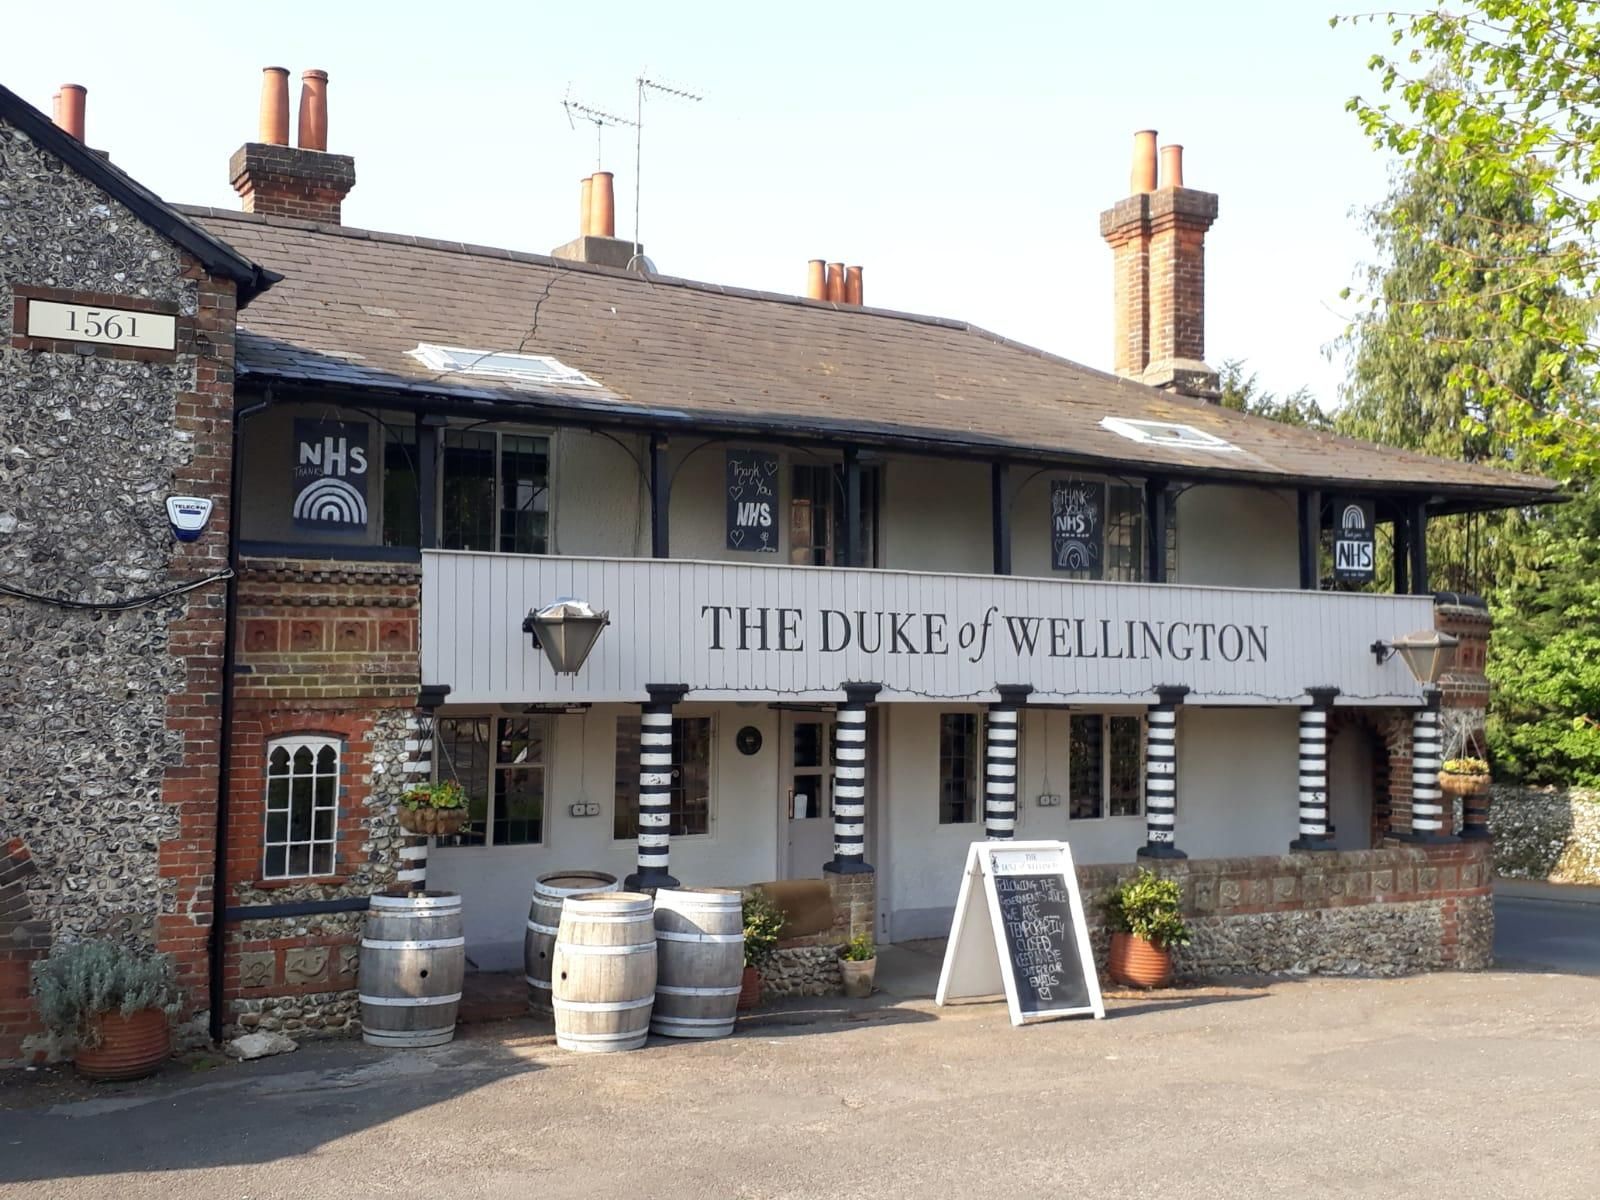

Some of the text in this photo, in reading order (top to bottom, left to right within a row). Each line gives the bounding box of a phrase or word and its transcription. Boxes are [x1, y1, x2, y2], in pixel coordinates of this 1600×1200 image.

[65, 309, 141, 341] 1561
[299, 436, 368, 476] NHS
[737, 502, 772, 527] NHS
[1056, 514, 1085, 533] NHS
[1338, 542, 1372, 568] NHS
[701, 605, 1269, 663] THE DUKE of WELLINGTON
[1040, 878, 1056, 891] THE
[1003, 903, 1041, 921] WE ARE
[1016, 935, 1052, 953] CLOSED
